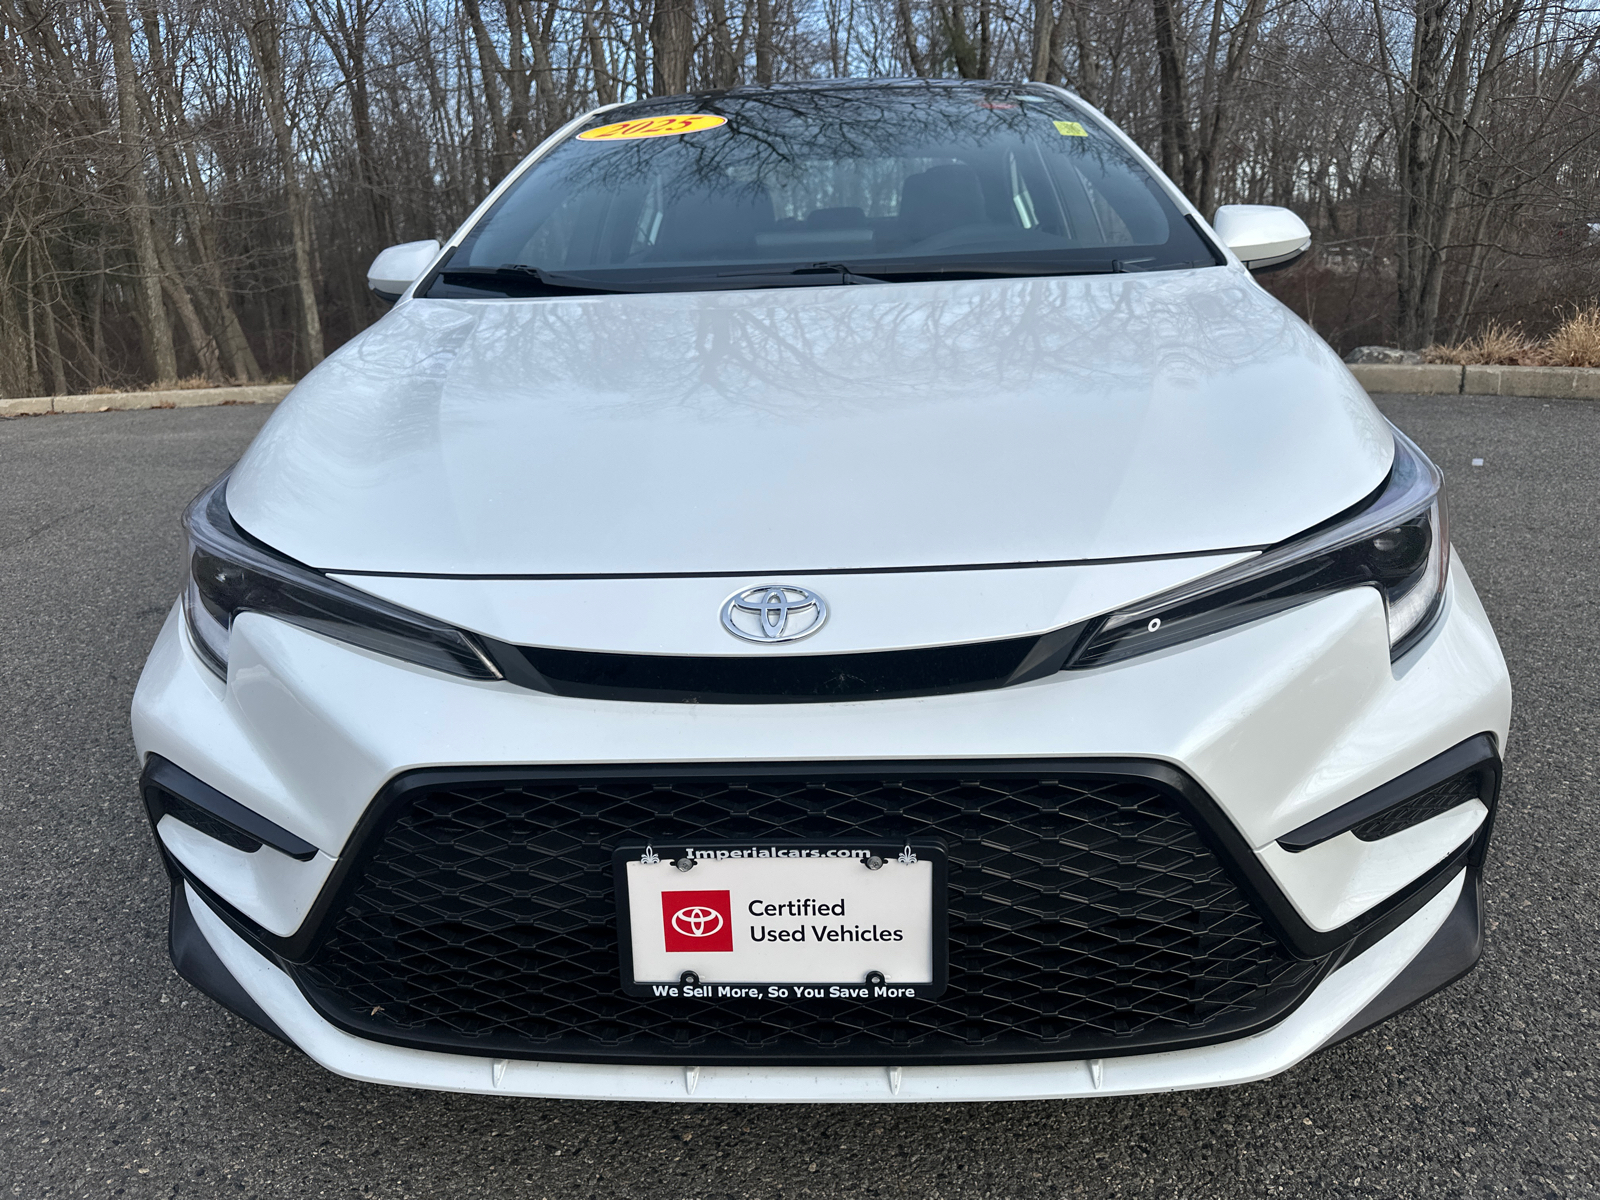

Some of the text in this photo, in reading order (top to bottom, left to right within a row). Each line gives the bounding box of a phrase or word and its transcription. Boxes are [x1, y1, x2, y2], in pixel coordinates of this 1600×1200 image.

[595, 116, 704, 138] 2025
[685, 847, 871, 861] Imperialcars.com
[748, 899, 846, 917] Certified
[750, 925, 904, 942] Used Vehicles
[652, 985, 915, 1000] We Sell More, So You Save More
